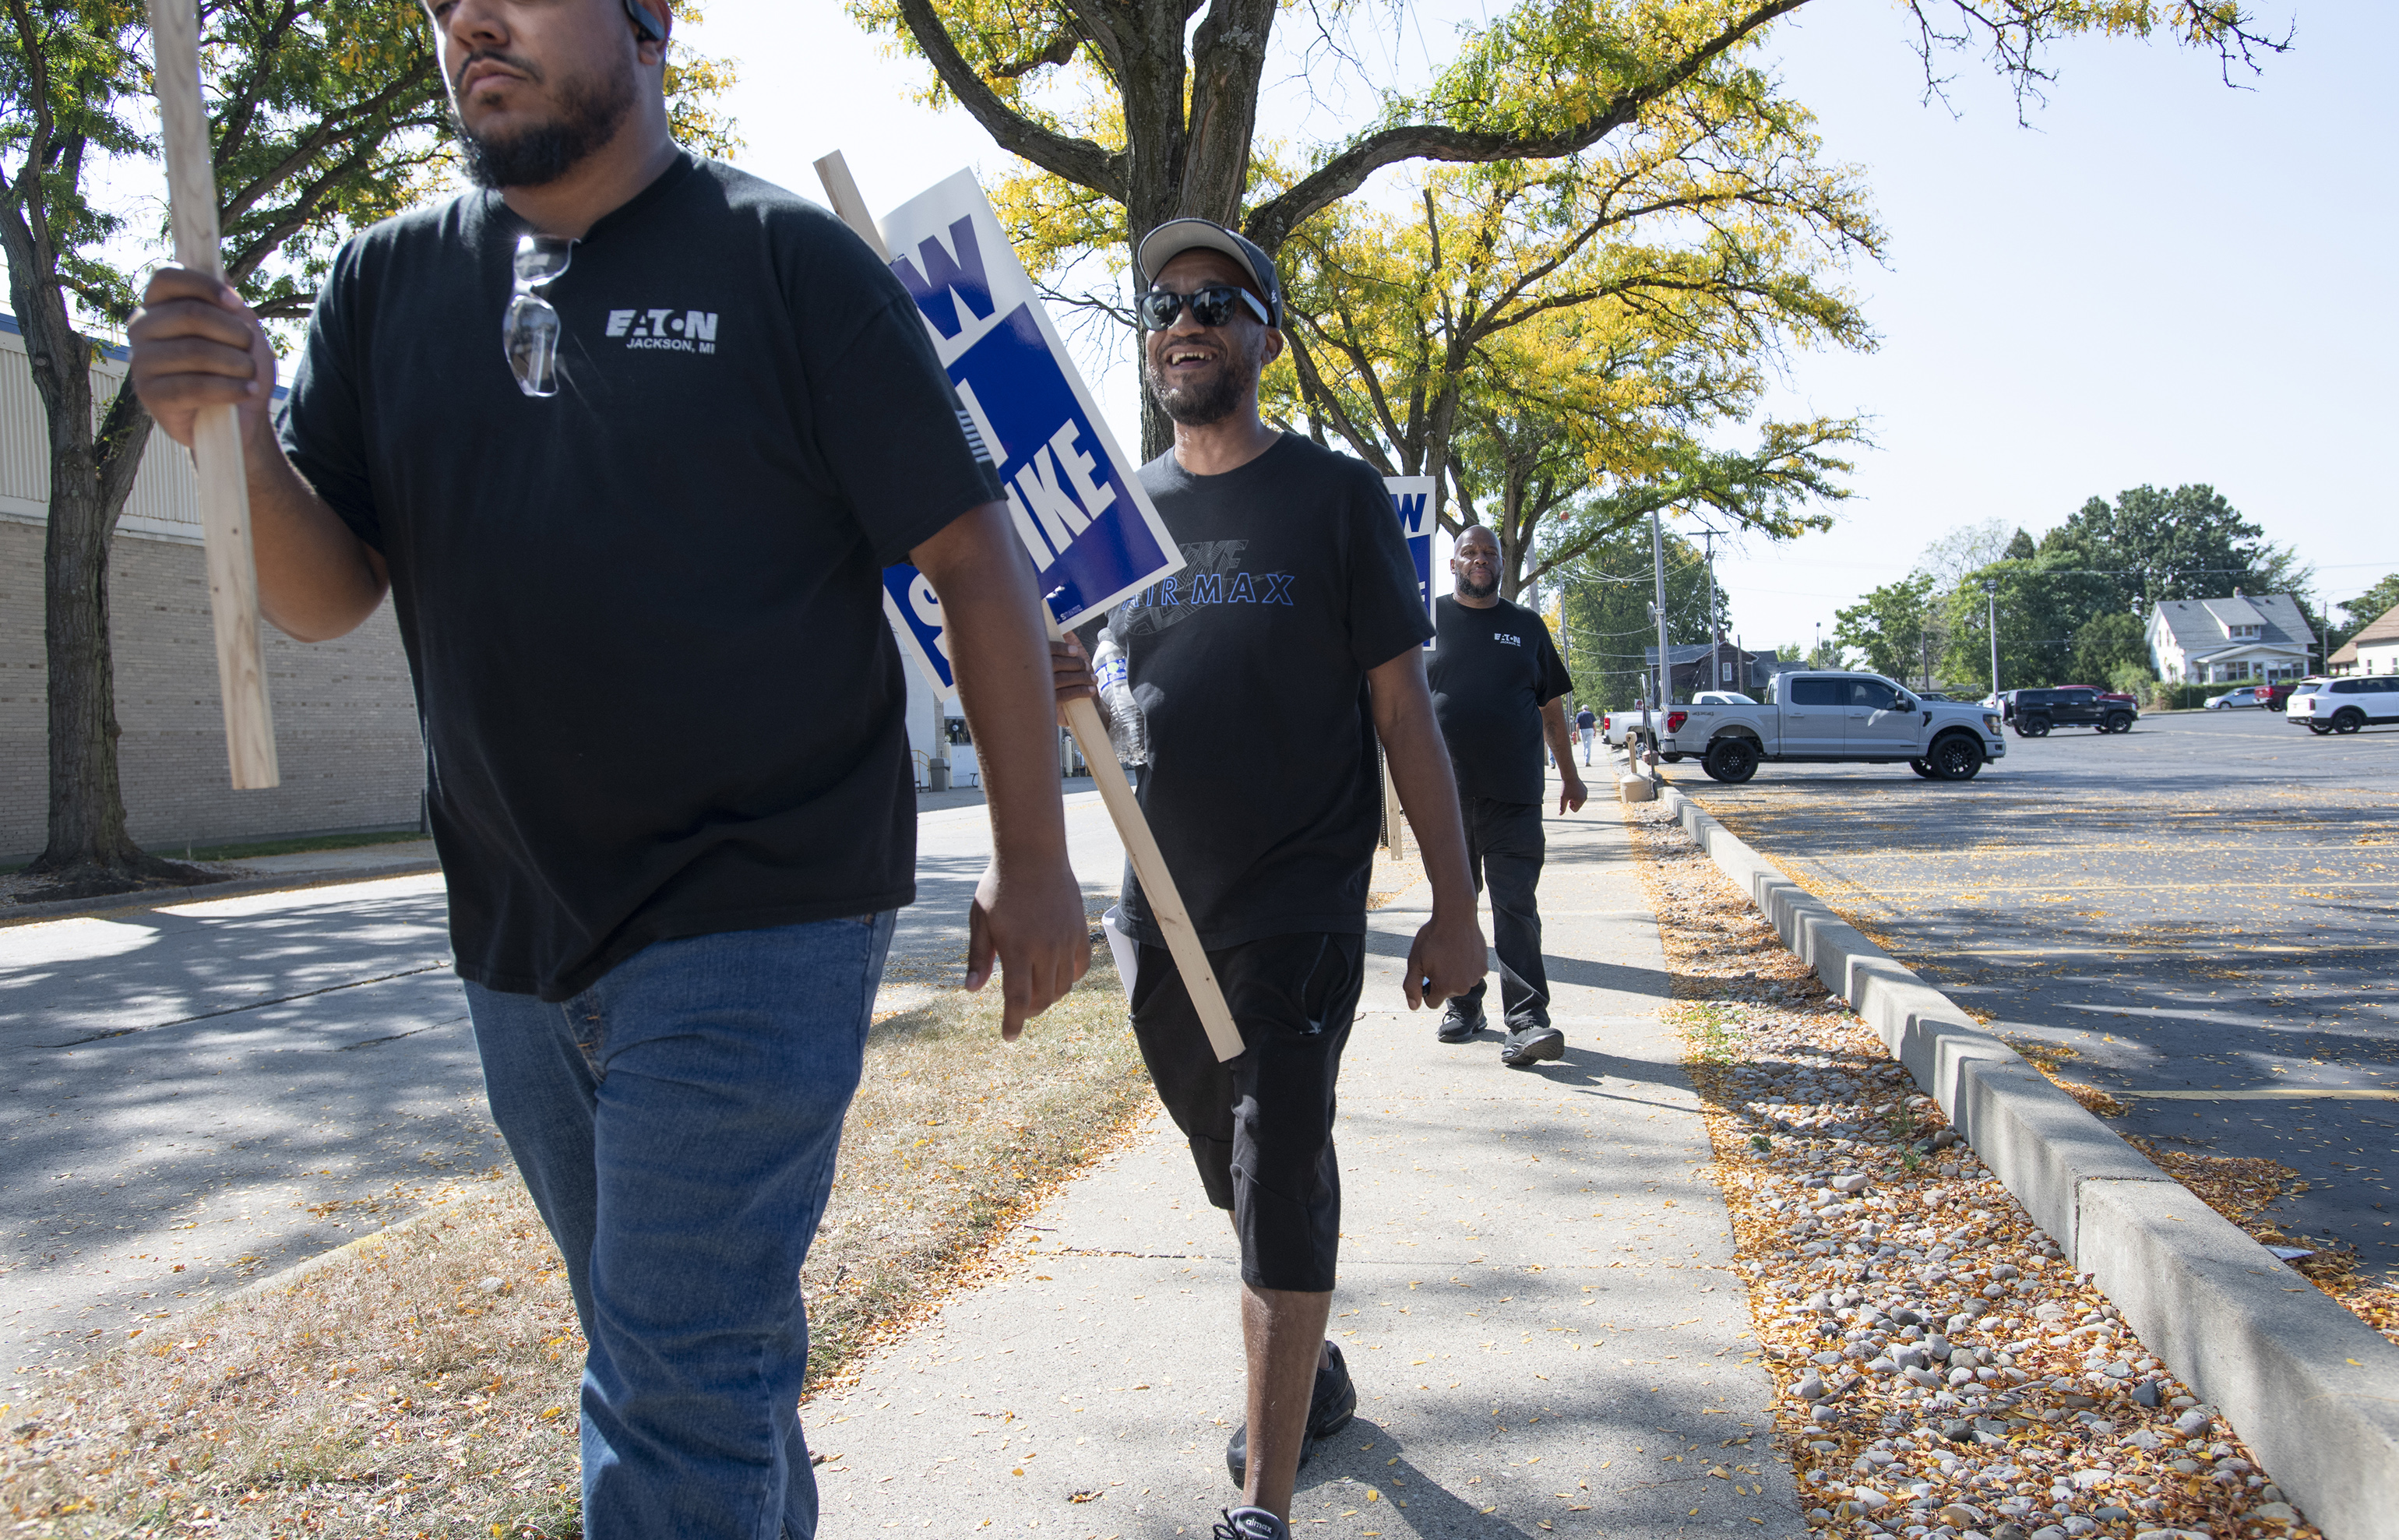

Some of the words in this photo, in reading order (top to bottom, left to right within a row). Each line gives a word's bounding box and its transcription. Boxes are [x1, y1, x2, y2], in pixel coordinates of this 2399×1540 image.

[606, 309, 718, 341] EATON
[626, 338, 695, 354] JACKSON,
[699, 342, 715, 354] MI
[1191, 573, 1295, 606] MAX
